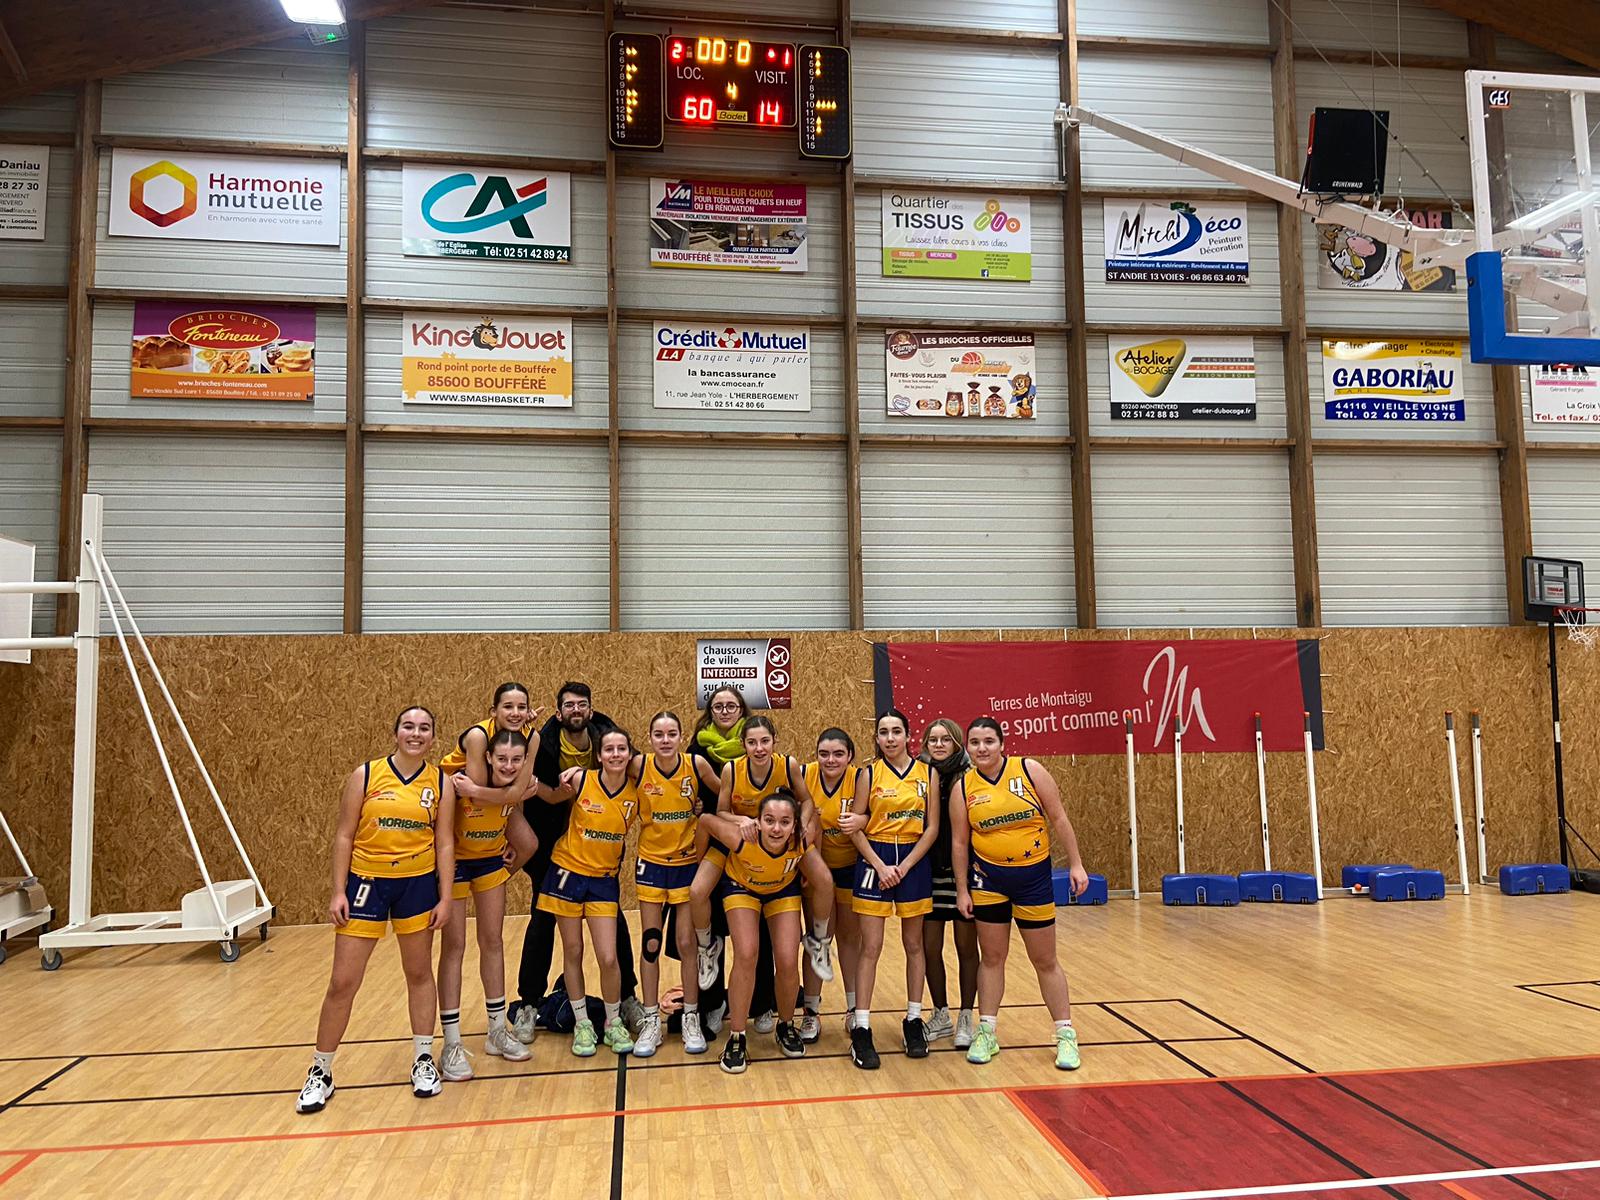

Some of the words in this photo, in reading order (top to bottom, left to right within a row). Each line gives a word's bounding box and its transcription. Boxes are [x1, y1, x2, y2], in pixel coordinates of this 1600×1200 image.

[672, 42, 683, 59] 2
[784, 48, 790, 65] 1
[676, 66, 705, 80] LOC.
[754, 70, 788, 84] VISIT.
[726, 82, 737, 99] 4
[1489, 90, 1510, 105] GES
[684, 97, 713, 120] 60
[759, 100, 780, 123] 14
[719, 111, 747, 120] Bodet
[0, 160, 41, 170] Daniau
[11, 182, 24, 190] 27
[209, 173, 323, 194] Harmonie
[667, 185, 691, 200] VM
[694, 186, 704, 194] LE
[706, 187, 747, 197] MEILLEUR
[749, 189, 774, 198] CHOIX
[208, 192, 323, 211] mutuelle
[714, 203, 755, 213] RÉNOVATION
[745, 198, 775, 206] PROJETS
[891, 194, 950, 209] Quartier
[220, 215, 257, 223] harmonie
[892, 213, 964, 230] TISSUS
[1119, 213, 1178, 250] Mitch
[1208, 235, 1242, 246] Peinture
[484, 246, 502, 257] Tél:
[503, 247, 515, 258] 02
[518, 248, 528, 258] 51
[530, 248, 542, 259] 42
[543, 249, 555, 259] 89
[556, 249, 569, 260] 24
[1199, 242, 1244, 255] Décoration
[672, 252, 712, 262] BOUFFÉRÉ
[1107, 271, 1119, 280] ST
[1119, 272, 1148, 280] ANDRE
[1190, 273, 1201, 281] 06
[187, 313, 268, 329] BRIOCHES
[183, 323, 270, 343] Fonteneau
[412, 323, 473, 348] King
[496, 327, 566, 350] Jouet
[657, 328, 717, 347] Crédit
[742, 331, 806, 350] Mutuel
[921, 337, 937, 345] LES
[938, 336, 981, 345] BRIOCHES
[981, 335, 1032, 344] OFFICIELLES
[661, 350, 679, 360] LA
[688, 353, 731, 364] banque
[749, 354, 767, 364] qui
[772, 355, 809, 365] parler
[1122, 350, 1175, 366] Atelier
[417, 362, 442, 371] Rond
[444, 362, 469, 372] point
[471, 364, 498, 373] porte
[500, 364, 512, 373] de
[514, 363, 557, 374] Bouffére
[688, 368, 697, 377] la
[700, 369, 777, 379] bancassurance
[1133, 366, 1174, 375] BOCAGE
[427, 376, 470, 388] 85600
[475, 376, 547, 390] BOUFFÉRÉ
[1332, 368, 1454, 389] GABORIAU
[429, 394, 545, 404] WWW.SMASHBASKET.FR
[729, 392, 799, 400] L'HERBERGEMENT
[1192, 407, 1251, 416] atelier-dubocage.fr
[1373, 403, 1456, 411] VIEILLEVIGNE
[1335, 411, 1358, 419] Tel.
[1442, 412, 1457, 420] 76
[703, 645, 757, 655] Chaussures
[703, 656, 716, 665] de
[718, 656, 740, 665] ville
[703, 668, 755, 678] INTERDITES
[988, 697, 1022, 712] Terres
[1025, 695, 1039, 709] de
[1041, 690, 1093, 708] Montaigu
[1013, 713, 1058, 739] sport
[1062, 712, 1119, 732] comme
[1122, 707, 1143, 727] on
[680, 776, 692, 797] 5
[1008, 777, 1024, 797] 4
[420, 786, 435, 808] 9
[623, 800, 635, 820] 7
[556, 869, 570, 890] 7
[353, 883, 372, 907] 9
